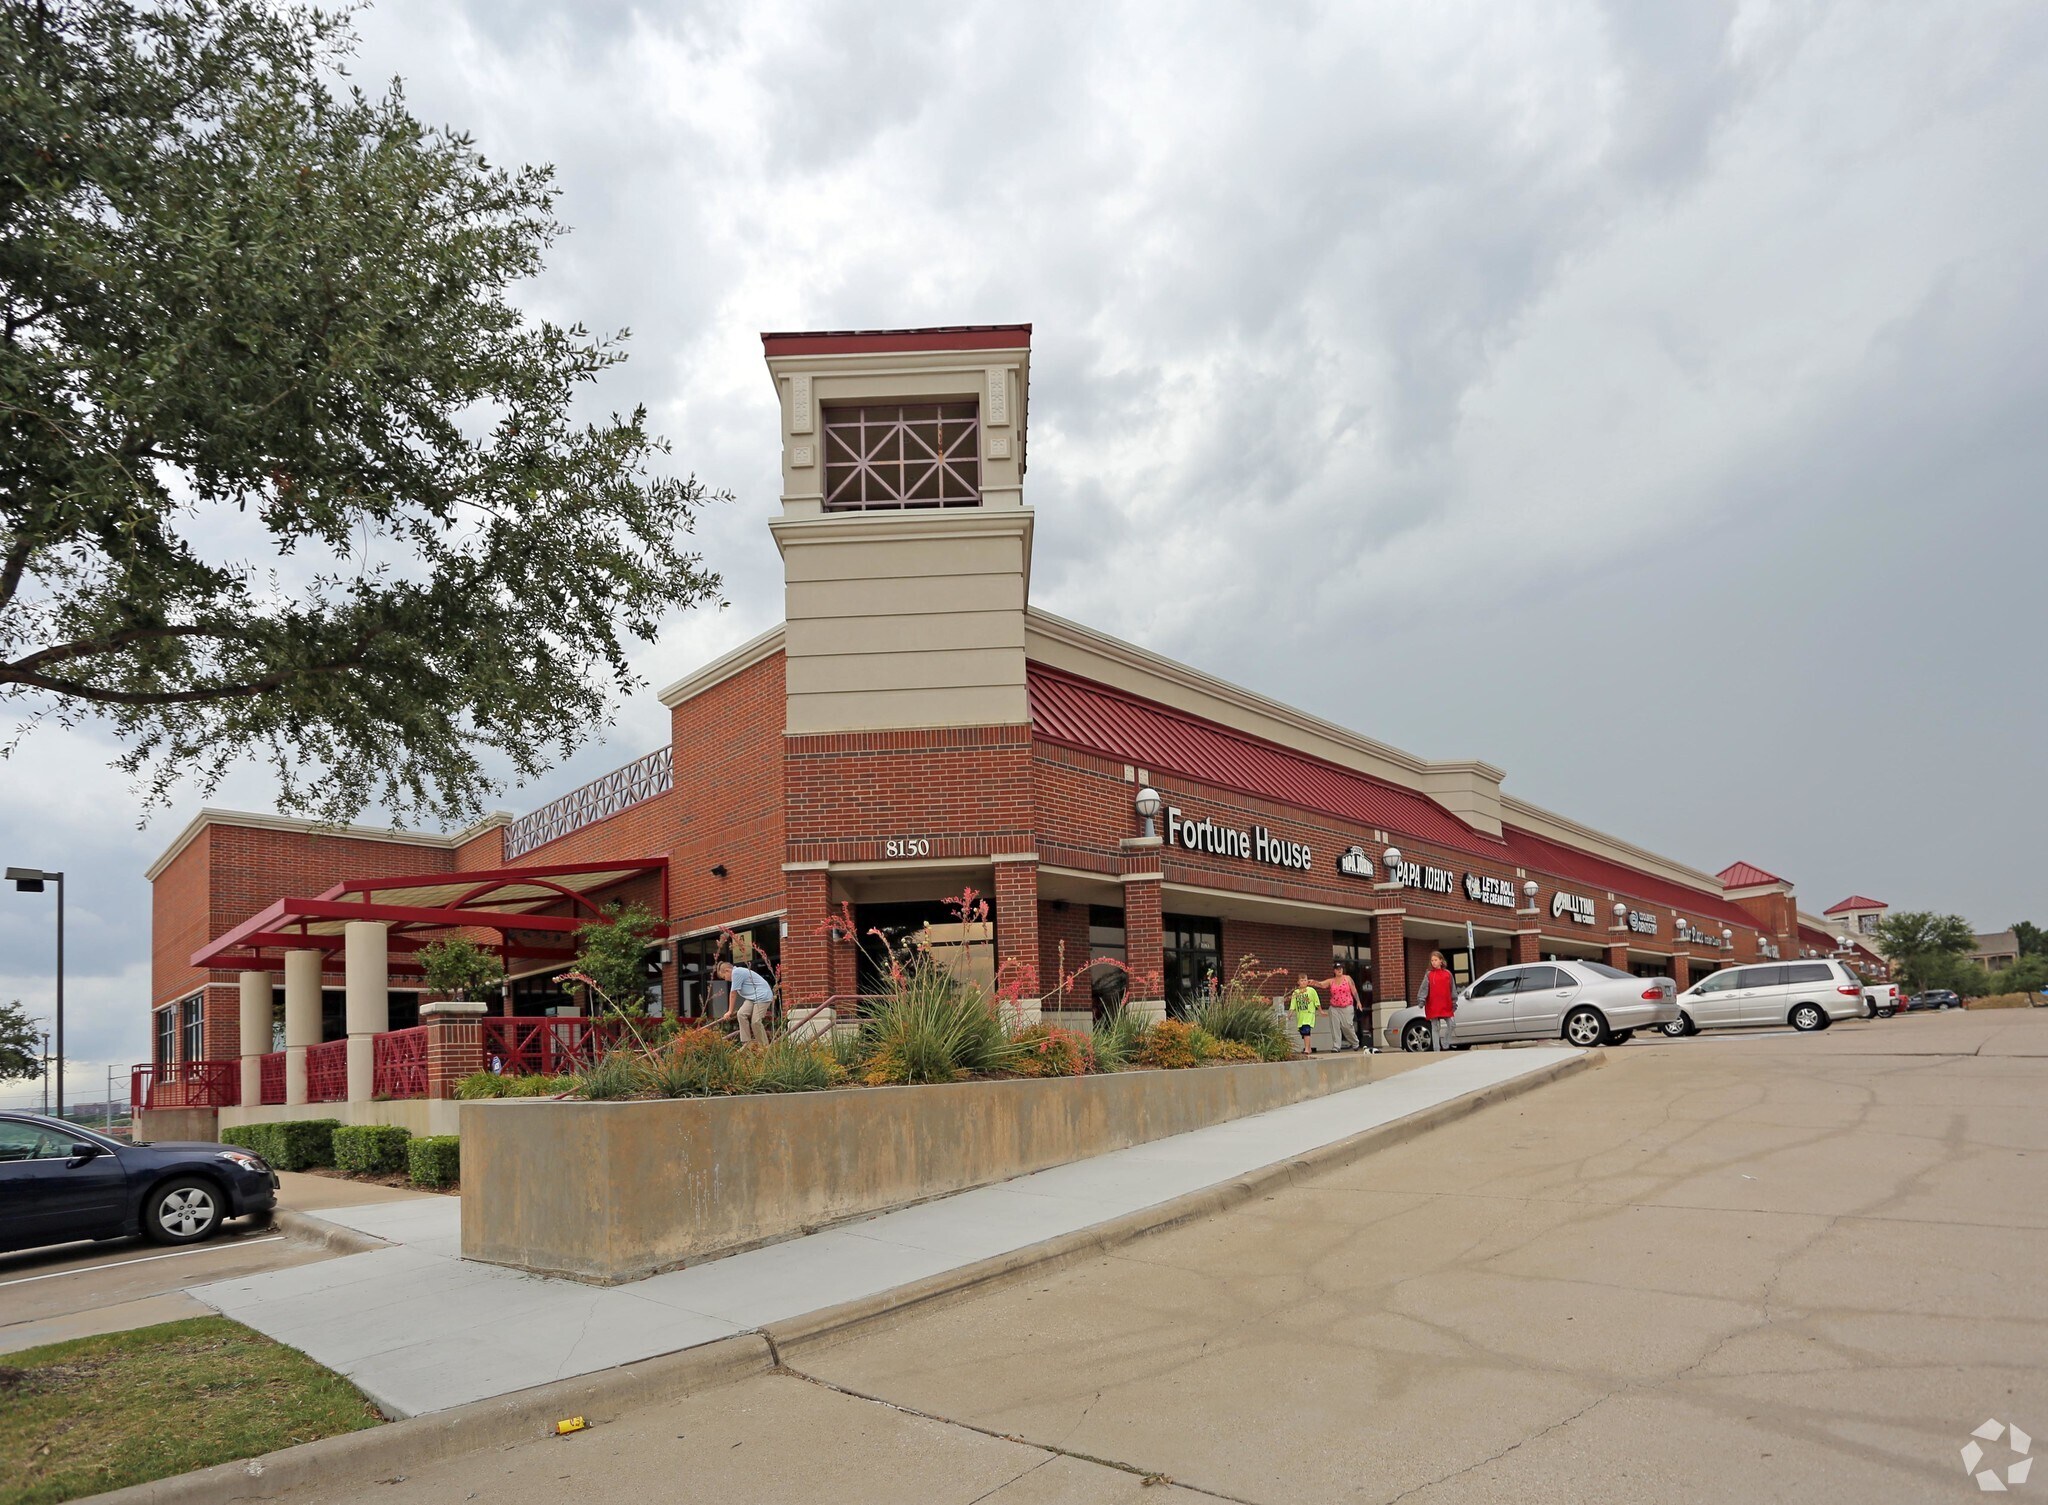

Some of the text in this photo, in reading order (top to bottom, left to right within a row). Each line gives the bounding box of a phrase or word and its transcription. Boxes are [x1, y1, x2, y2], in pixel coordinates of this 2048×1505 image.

[886, 839, 930, 857] 8150
[1167, 806, 1312, 870] Fortune House
[1396, 861, 1454, 894] PAPA JOHN'S
[1482, 876, 1515, 897] LET'S ROLL
[1579, 896, 1595, 916] THAI
